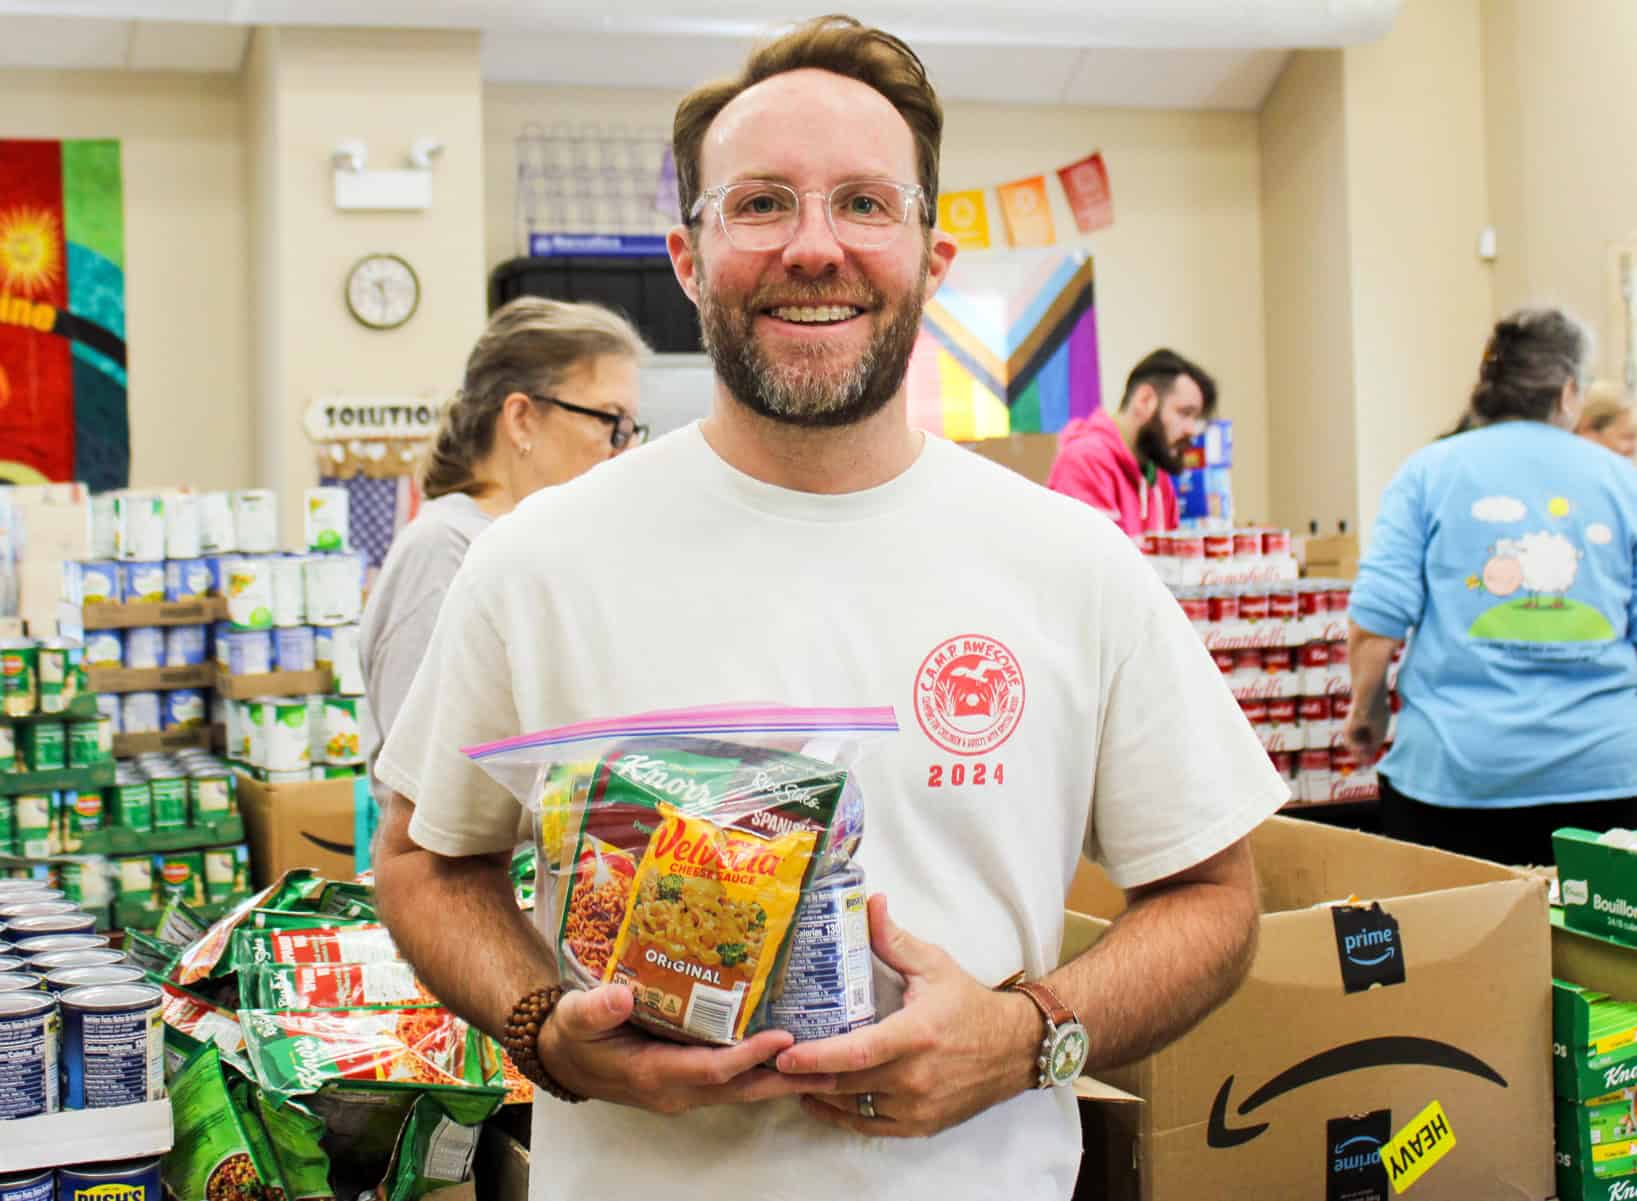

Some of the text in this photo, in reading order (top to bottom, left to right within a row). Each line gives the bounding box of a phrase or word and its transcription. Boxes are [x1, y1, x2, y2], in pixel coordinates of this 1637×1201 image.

[325, 405, 438, 427] SOLUTIO
[963, 640, 1020, 687] AWESOME
[618, 754, 713, 806] Knorr
[928, 763, 1004, 788] 2024
[717, 870, 756, 886] SAUCE
[1344, 928, 1392, 954] prime
[645, 949, 721, 985] ORIGINAL
[1389, 1113, 1449, 1180] HEAVY
